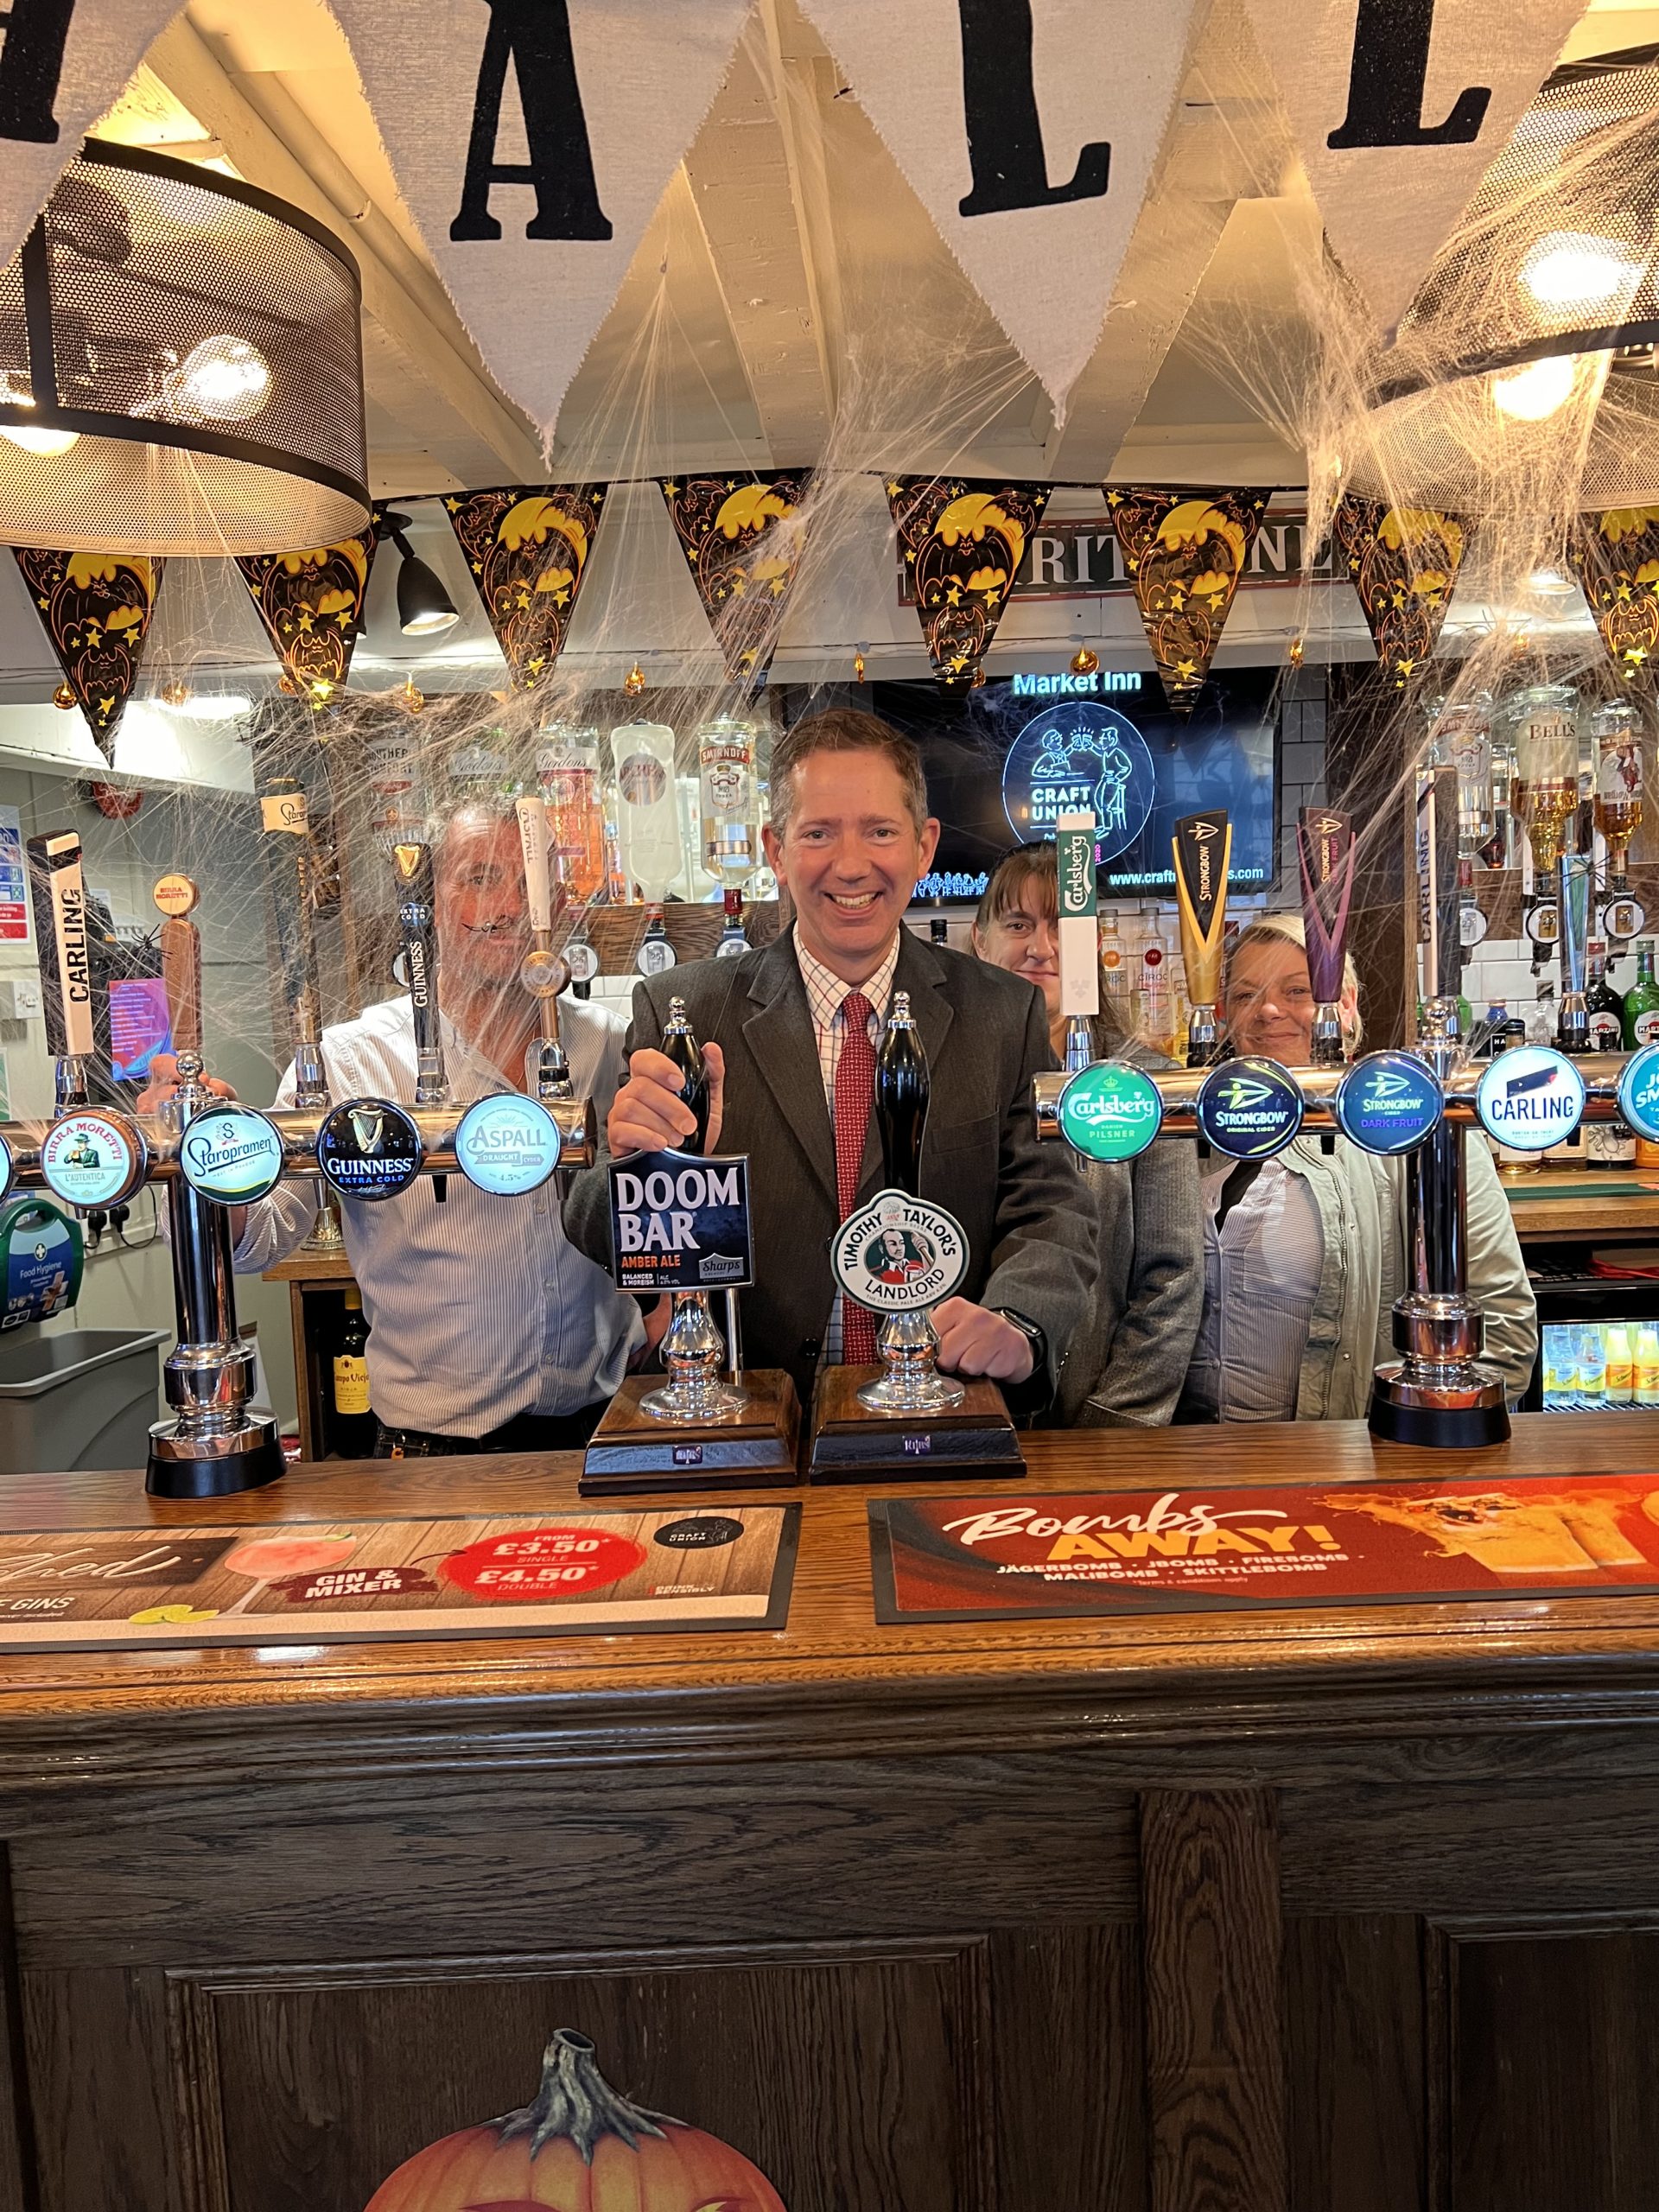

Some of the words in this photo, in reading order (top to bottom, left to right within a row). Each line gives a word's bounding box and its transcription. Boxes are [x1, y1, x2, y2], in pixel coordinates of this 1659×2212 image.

[1014, 672, 1098, 694] Market
[1105, 671, 1141, 690] Inn
[1529, 722, 1576, 739] BELL'S
[702, 747, 747, 760] SMIRNOFF
[1032, 786, 1090, 803] CRAFT
[1321, 838, 1331, 882] STRONGBOW
[1331, 836, 1339, 861] FRUIT
[1065, 836, 1090, 912] Carlsberg
[1199, 845, 1211, 901] STRONGBOW
[60, 888, 89, 1002] CARLING
[410, 940, 429, 1007] GUINNESS
[1068, 1092, 1155, 1122] Carlsberg
[1363, 1098, 1422, 1112] STRONGBOW
[1491, 1096, 1573, 1122] CARLING
[1216, 1111, 1287, 1127] STRONGBOW
[1361, 1119, 1390, 1128] DARK
[1392, 1117, 1424, 1128] FRUIT
[48, 1126, 75, 1163] BIRRA
[75, 1122, 123, 1160] MORETTI
[467, 1125, 547, 1154] ASPALL
[1089, 1129, 1135, 1138] PILSNER
[188, 1137, 273, 1177] Staropramen
[327, 1158, 410, 1175] GUINNESS
[65, 1173, 106, 1182] L'AUTENTICA
[615, 1166, 741, 1211] DOOM
[618, 1211, 701, 1252] BAR
[843, 1213, 883, 1271] TIMOTHY
[903, 1209, 956, 1256] TAYLOR'S
[20, 1266, 36, 1279] Food
[36, 1262, 62, 1274] Hygiene
[621, 1255, 658, 1268] AMBER
[660, 1255, 681, 1268] ALE
[865, 1268, 944, 1300] LANDLORD
[942, 1493, 1288, 1545] Bombs
[1046, 1524, 1343, 1560] AWAY!
[996, 1561, 1122, 1573] JÄGERBOMB
[1147, 1558, 1219, 1568] JBOMB
[1241, 1554, 1350, 1565] FIREBOMB
[1043, 1569, 1160, 1581] MALIBOMB
[1182, 1563, 1328, 1576] SKITTLEBOMB
[304, 1579, 403, 1599] MIXER
[315, 1572, 366, 1586] GIN
[374, 1569, 398, 1580] &
[497, 1582, 557, 1591] DOUBLE
[10, 1597, 76, 1611] GINS
